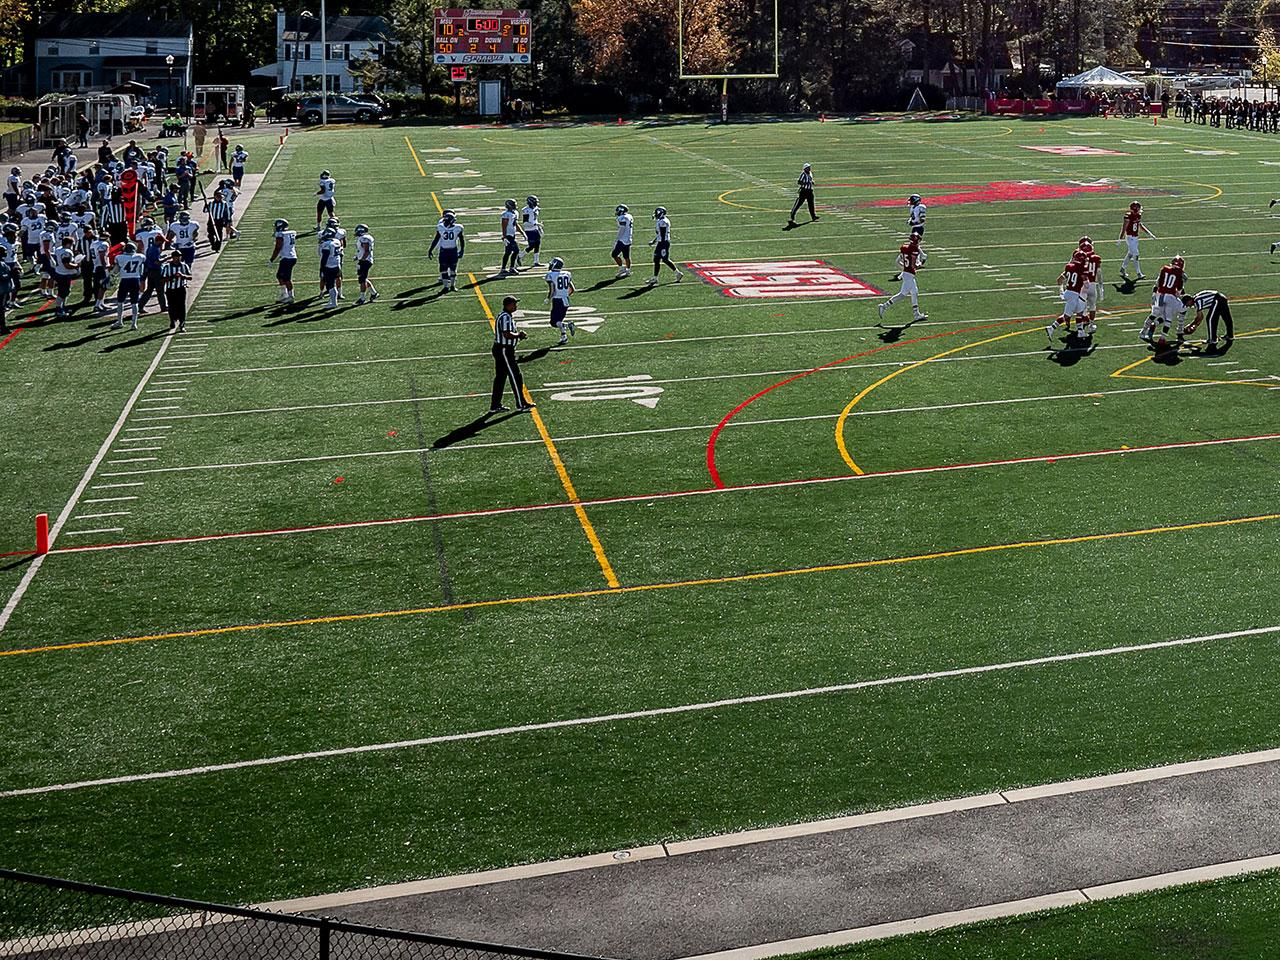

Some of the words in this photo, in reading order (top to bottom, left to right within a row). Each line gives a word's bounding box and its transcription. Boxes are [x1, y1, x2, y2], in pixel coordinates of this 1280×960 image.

[443, 24, 453, 35] 10
[475, 19, 498, 30] 6:00
[458, 28, 464, 36] 2
[520, 25, 527, 35] 0
[440, 44, 453, 53] 50
[470, 44, 477, 53] 2
[489, 44, 496, 53] 4
[517, 44, 526, 53] 16
[452, 67, 466, 78] 25
[179, 230, 189, 239] 91
[443, 231, 455, 241] 30
[123, 260, 139, 273] 47
[556, 276, 569, 290] 80
[1065, 271, 1078, 287] 29
[1163, 271, 1177, 288] 10
[543, 375, 664, 402] 10
